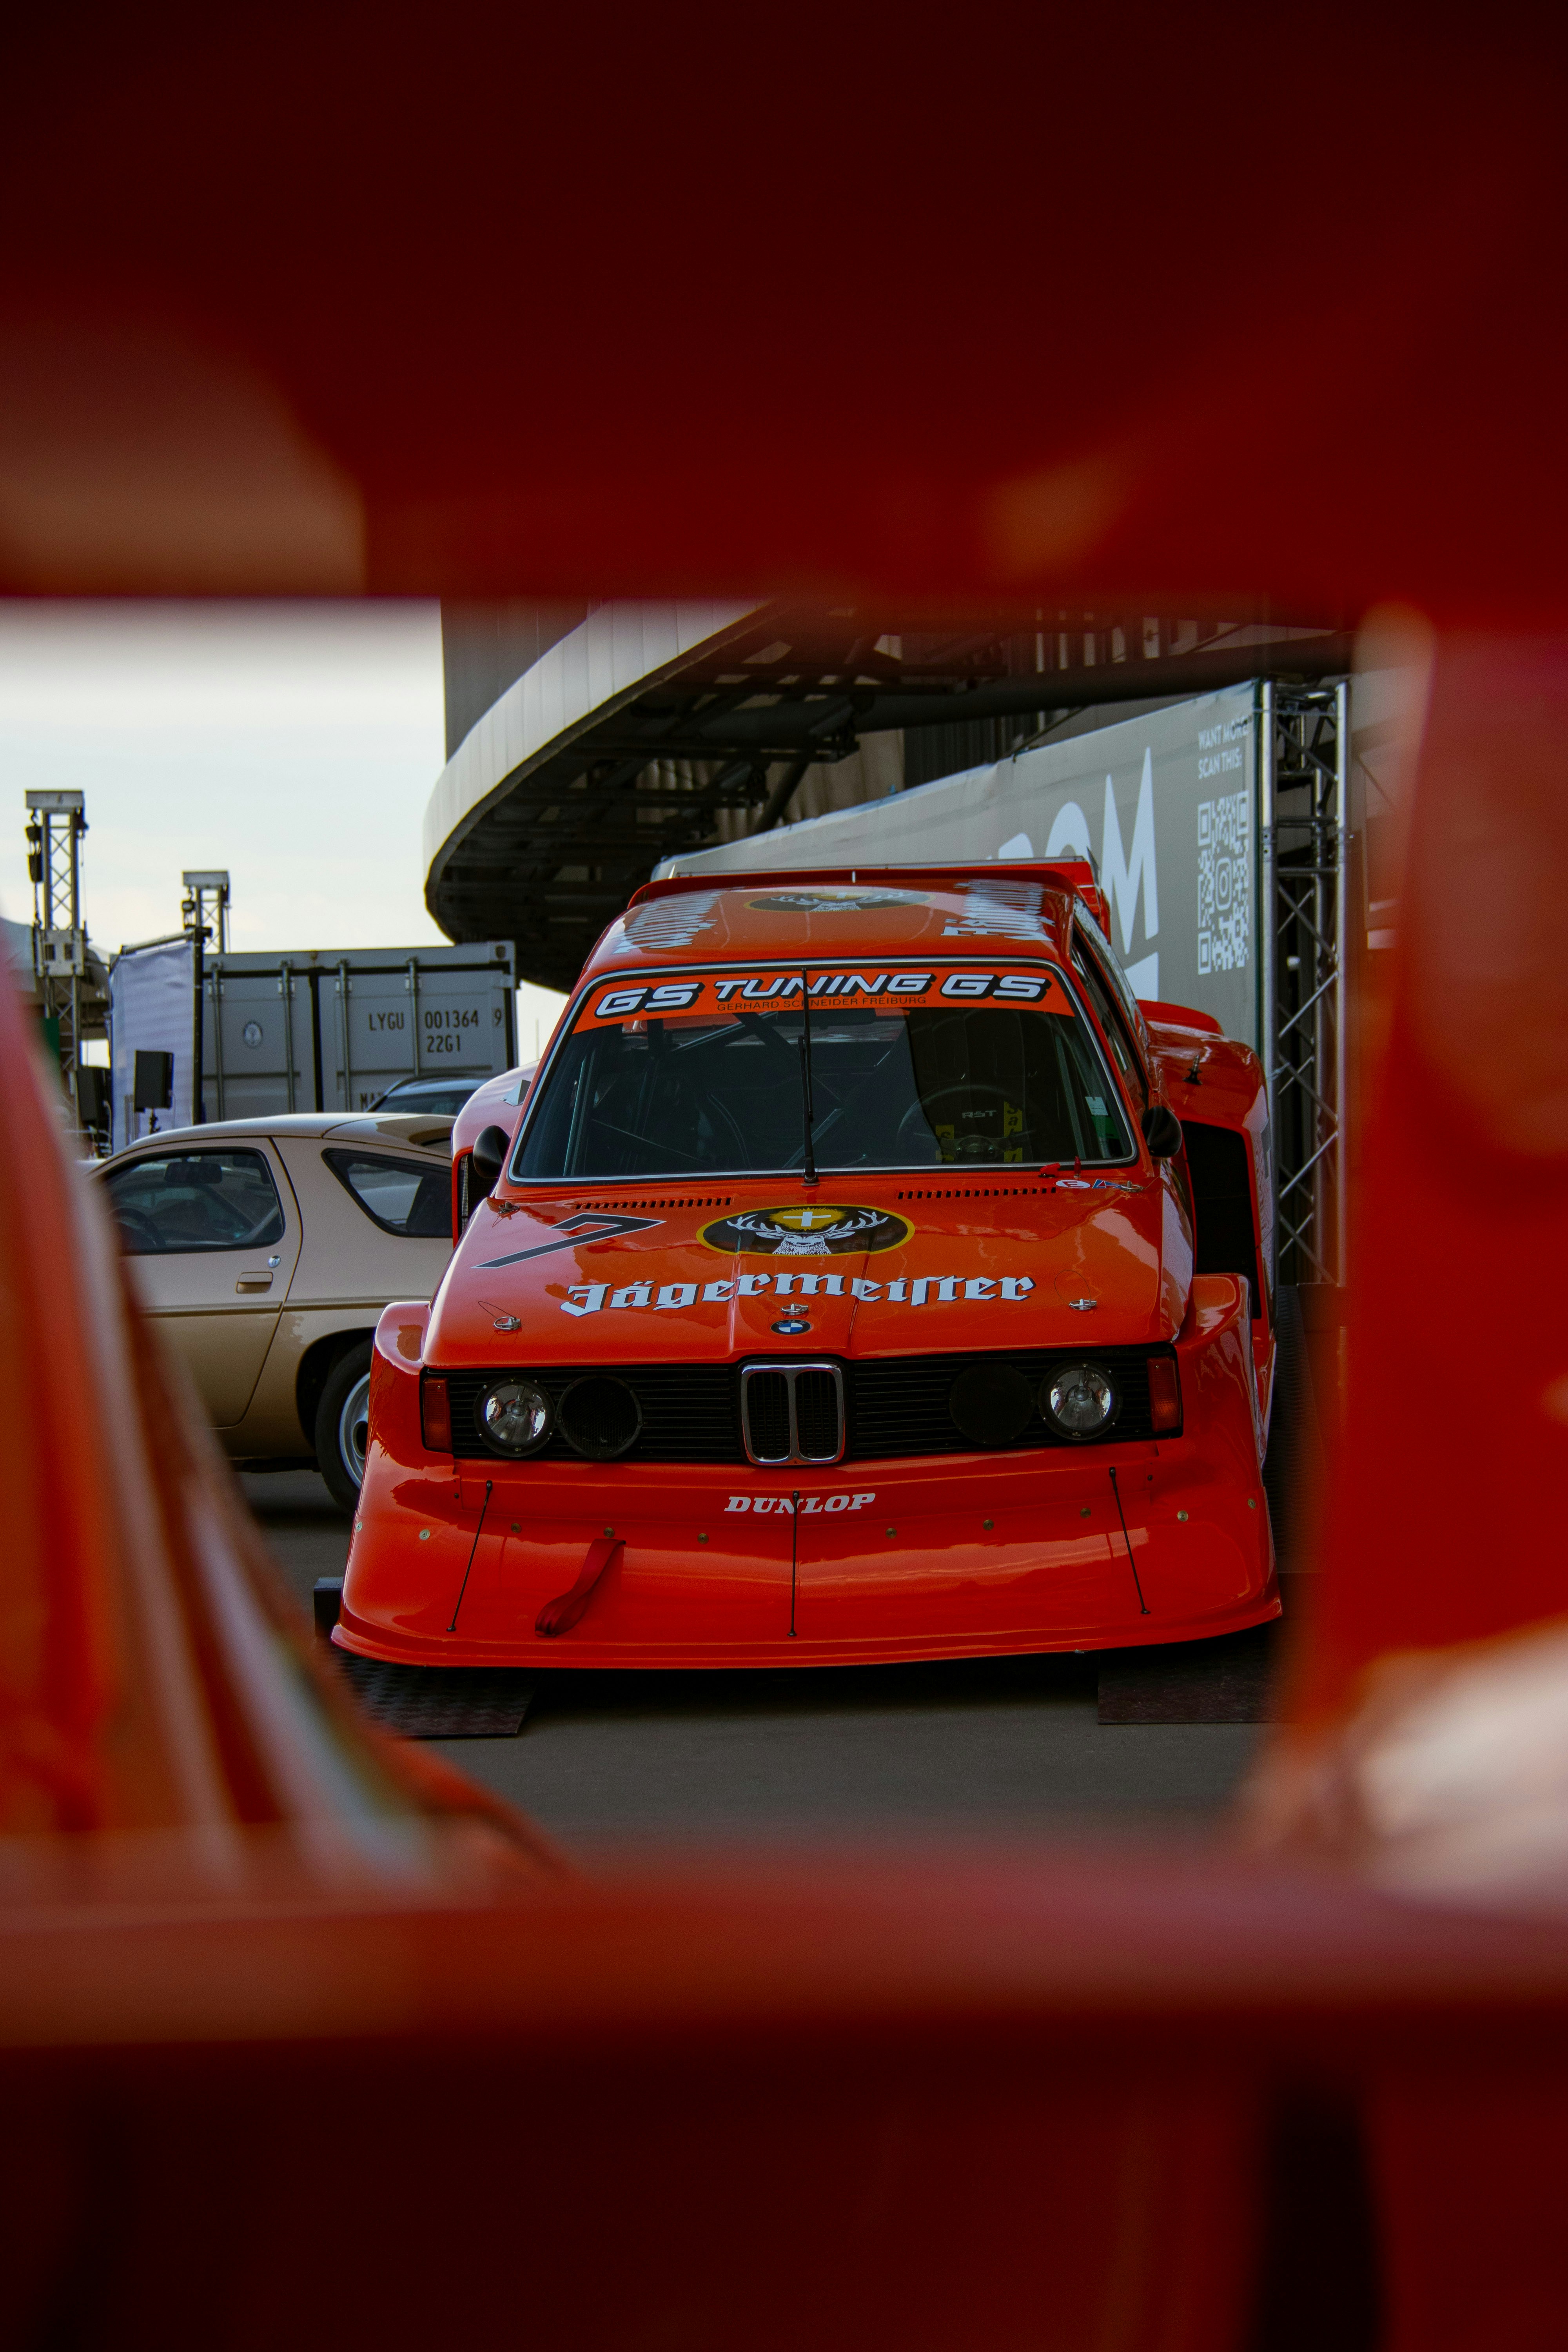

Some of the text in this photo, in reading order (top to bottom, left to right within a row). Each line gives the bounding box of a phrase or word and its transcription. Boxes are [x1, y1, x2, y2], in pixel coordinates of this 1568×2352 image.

[1198, 724, 1222, 751] WANT
[1198, 753, 1220, 779] SCAN
[594, 973, 1052, 1019] GS TUNING GS
[717, 996, 926, 1011] GERHARD SCHNEIDER FREIBURG
[368, 1007, 502, 1031] LYGU 001364 9
[427, 1034, 461, 1053] 22G1
[470, 1213, 667, 1269] 7
[724, 1493, 875, 1514] DUNLOP
